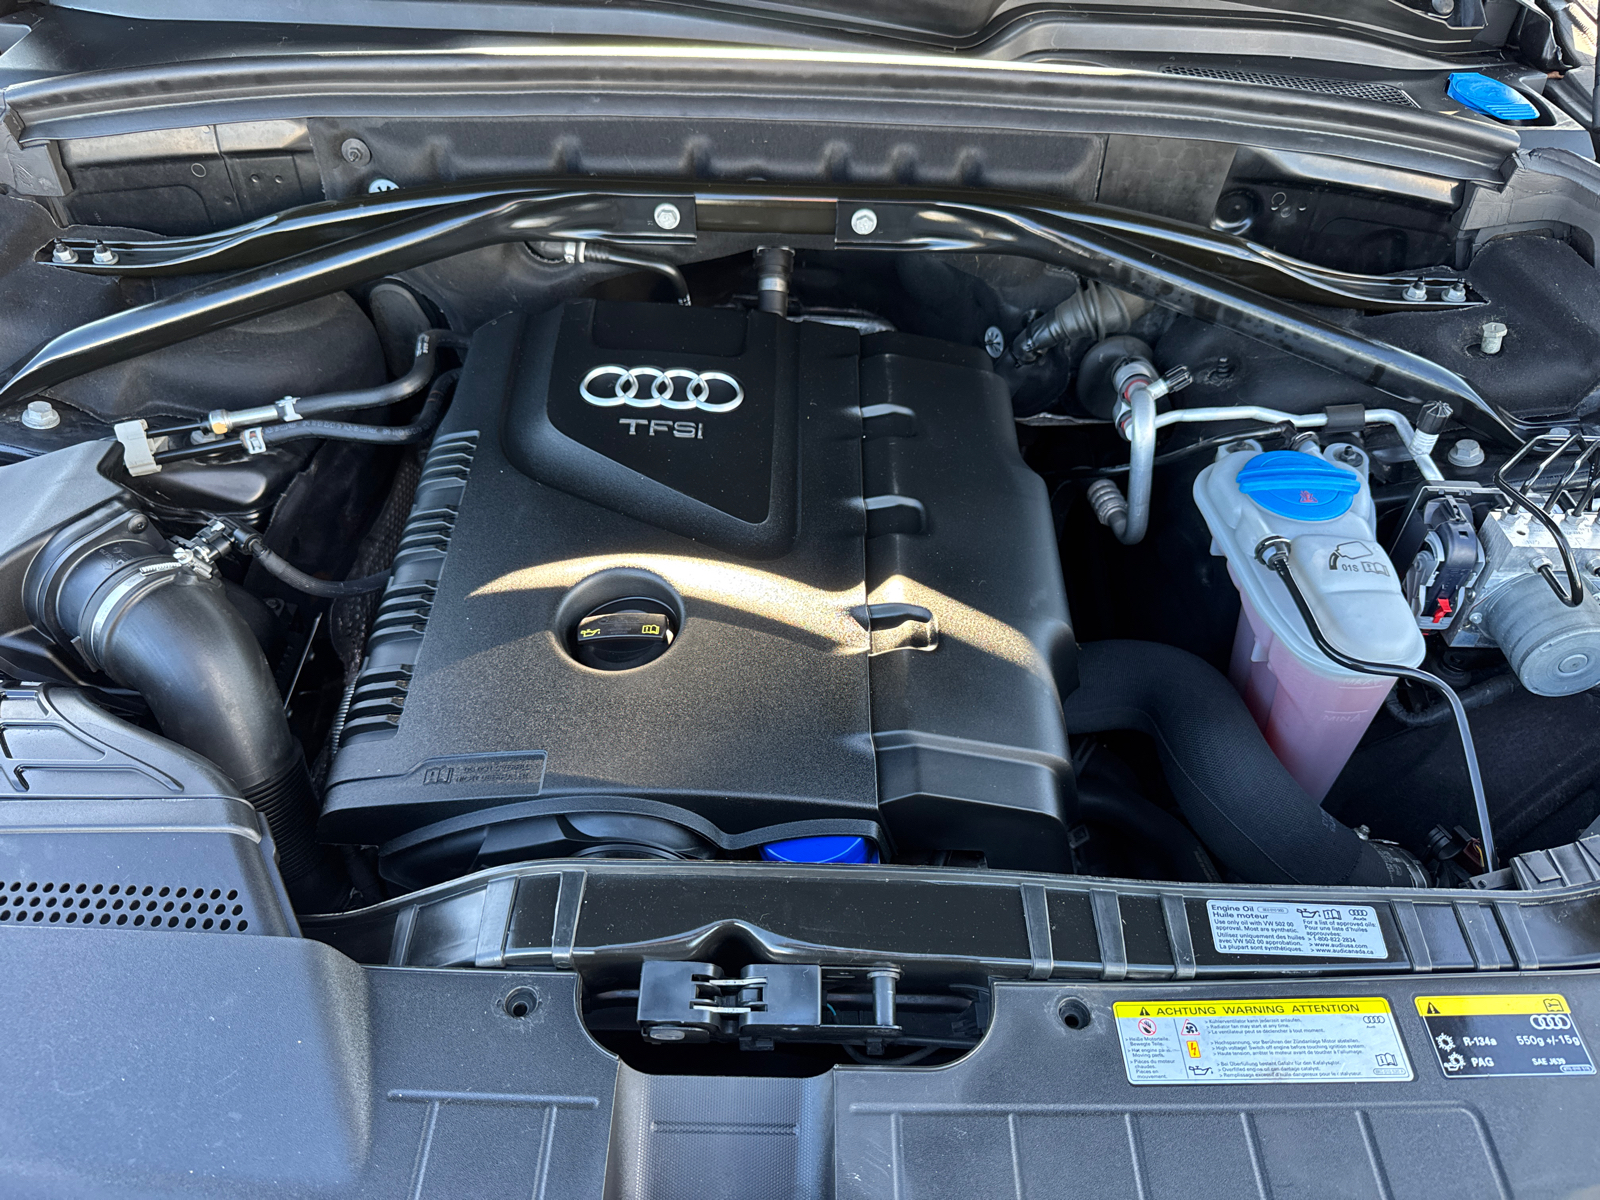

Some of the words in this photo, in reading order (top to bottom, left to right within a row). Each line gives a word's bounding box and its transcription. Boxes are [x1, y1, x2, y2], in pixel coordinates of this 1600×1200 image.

[619, 418, 704, 439] TFSI
[1342, 564, 1359, 572] 01S
[1156, 1006, 1216, 1016] ACHTUNG
[1222, 1006, 1284, 1014] WARNING
[1292, 1004, 1360, 1013] ATTENTION
[1463, 1037, 1497, 1046] R-134a
[1516, 1036, 1544, 1047] 550g
[1471, 1058, 1495, 1067] PAG
